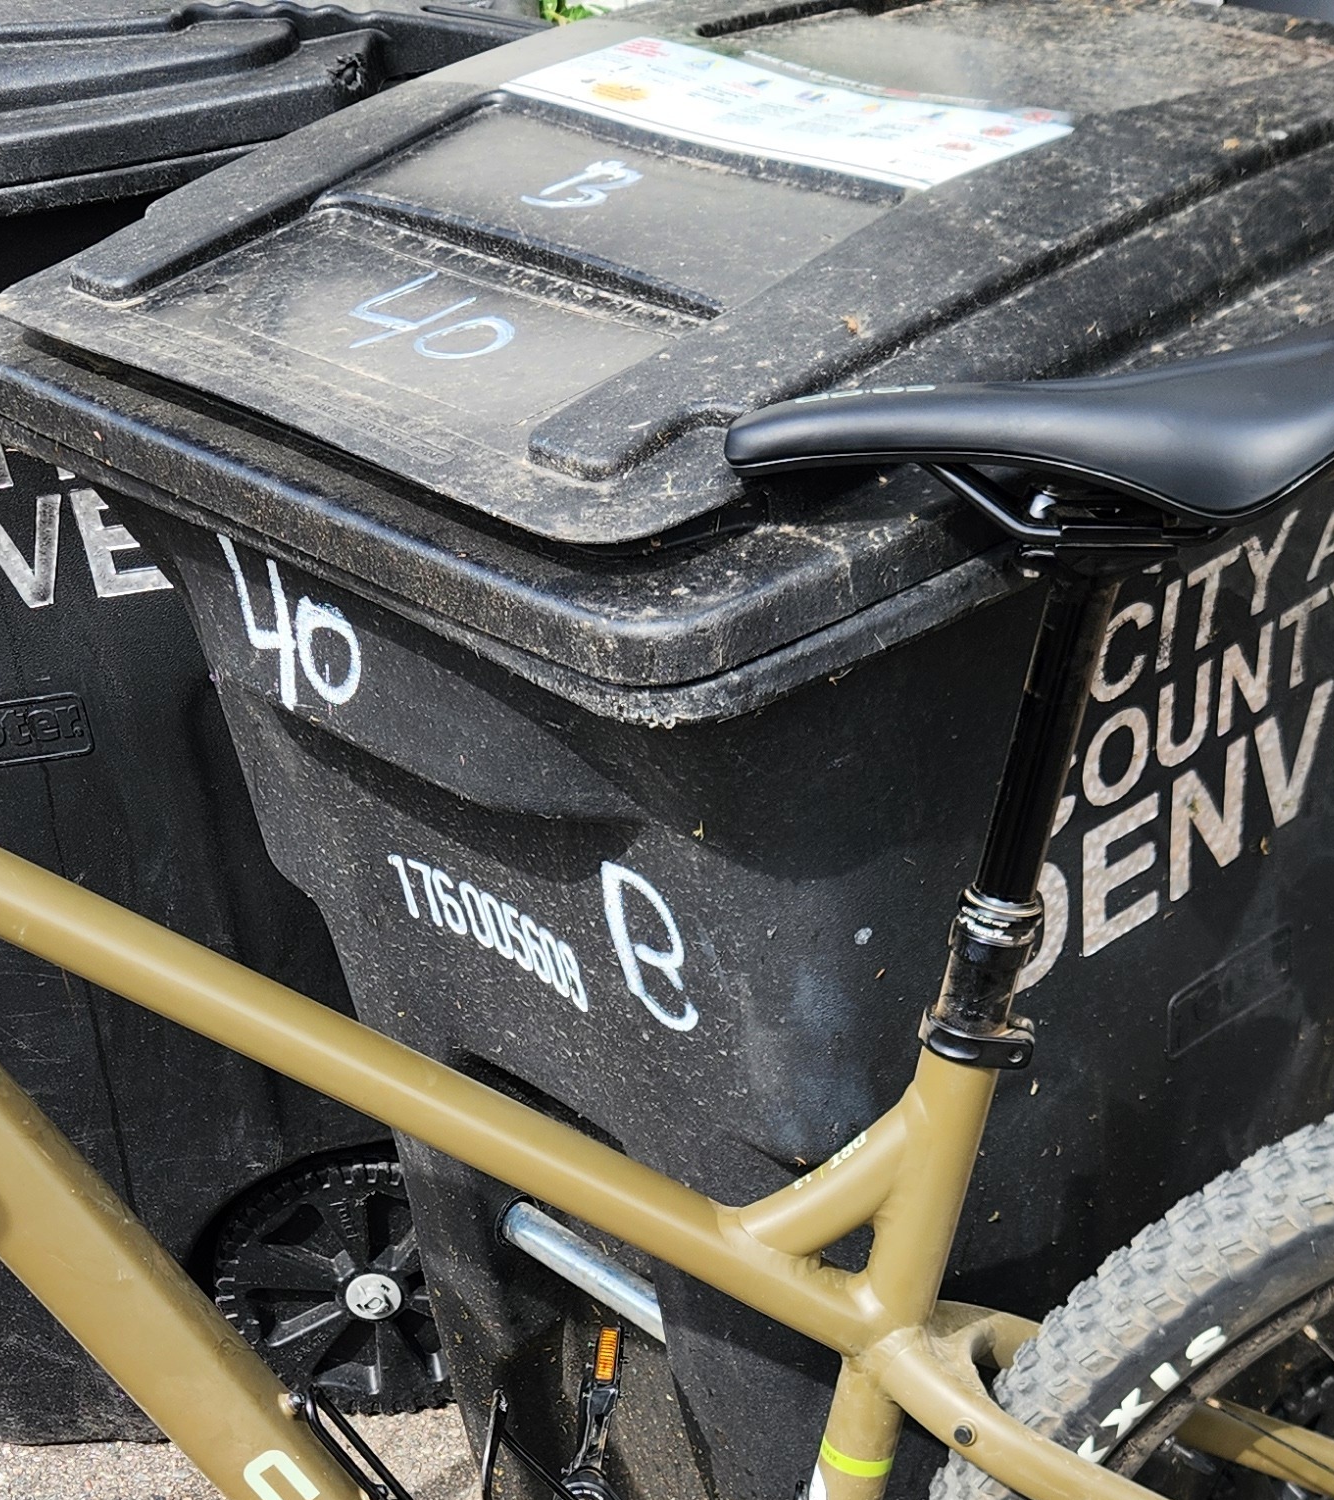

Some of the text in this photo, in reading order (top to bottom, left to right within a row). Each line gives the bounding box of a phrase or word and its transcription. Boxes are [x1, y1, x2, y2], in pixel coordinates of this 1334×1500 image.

[348, 271, 516, 360] 40
[216, 532, 362, 711] 40
[1090, 510, 1300, 702] CITY
